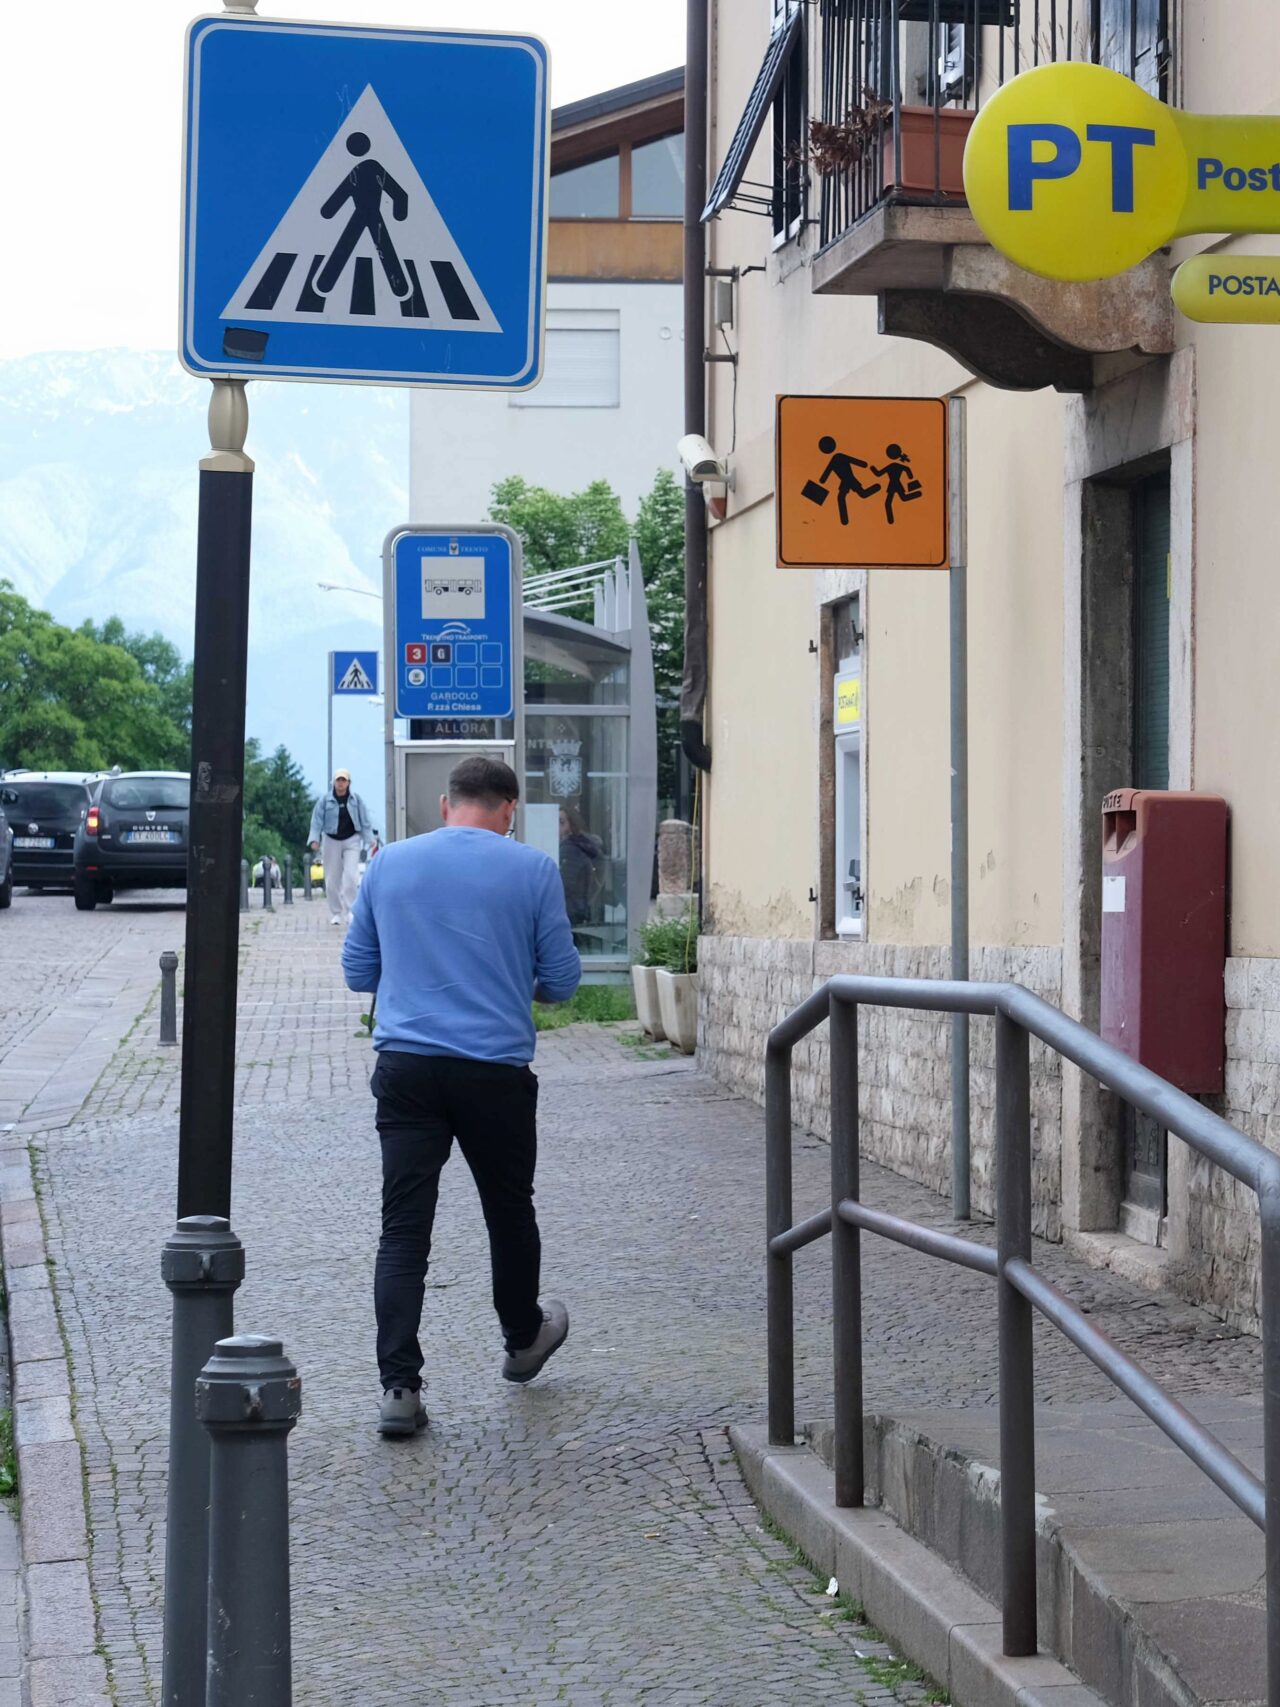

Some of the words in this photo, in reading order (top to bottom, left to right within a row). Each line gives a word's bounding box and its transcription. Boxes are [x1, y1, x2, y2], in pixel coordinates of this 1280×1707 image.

[1007, 123, 1155, 213] PT
[412, 648, 422, 660] 3
[430, 692, 478, 700] GARDOLO
[451, 702, 481, 711] Chiesa
[435, 722, 488, 733] ALLORA
